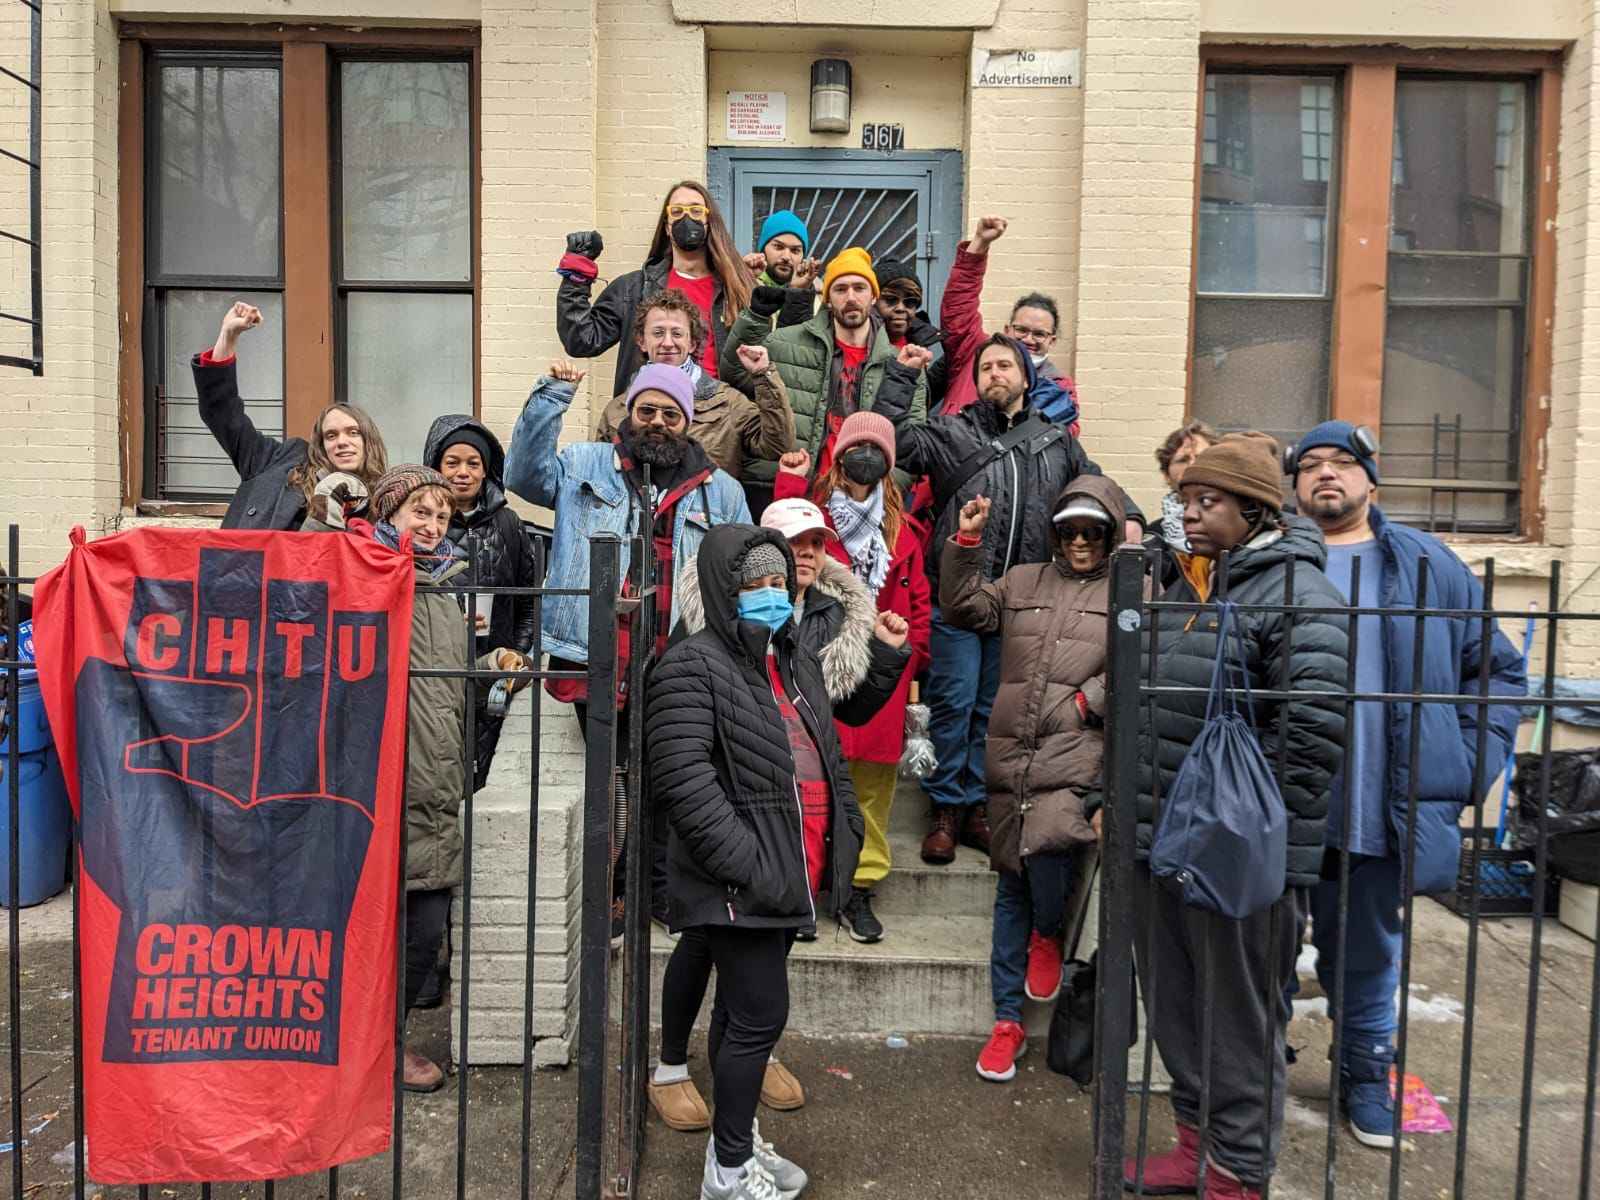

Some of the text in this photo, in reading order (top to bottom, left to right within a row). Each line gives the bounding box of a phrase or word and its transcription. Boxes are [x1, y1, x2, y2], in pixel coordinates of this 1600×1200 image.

[1017, 51, 1036, 62] No
[980, 73, 1073, 85] Advertisement
[863, 126, 902, 146] 567
[135, 923, 333, 980] CROWN
[131, 976, 325, 1021] HEIGHTS
[130, 1026, 321, 1053] TENANT UNION
